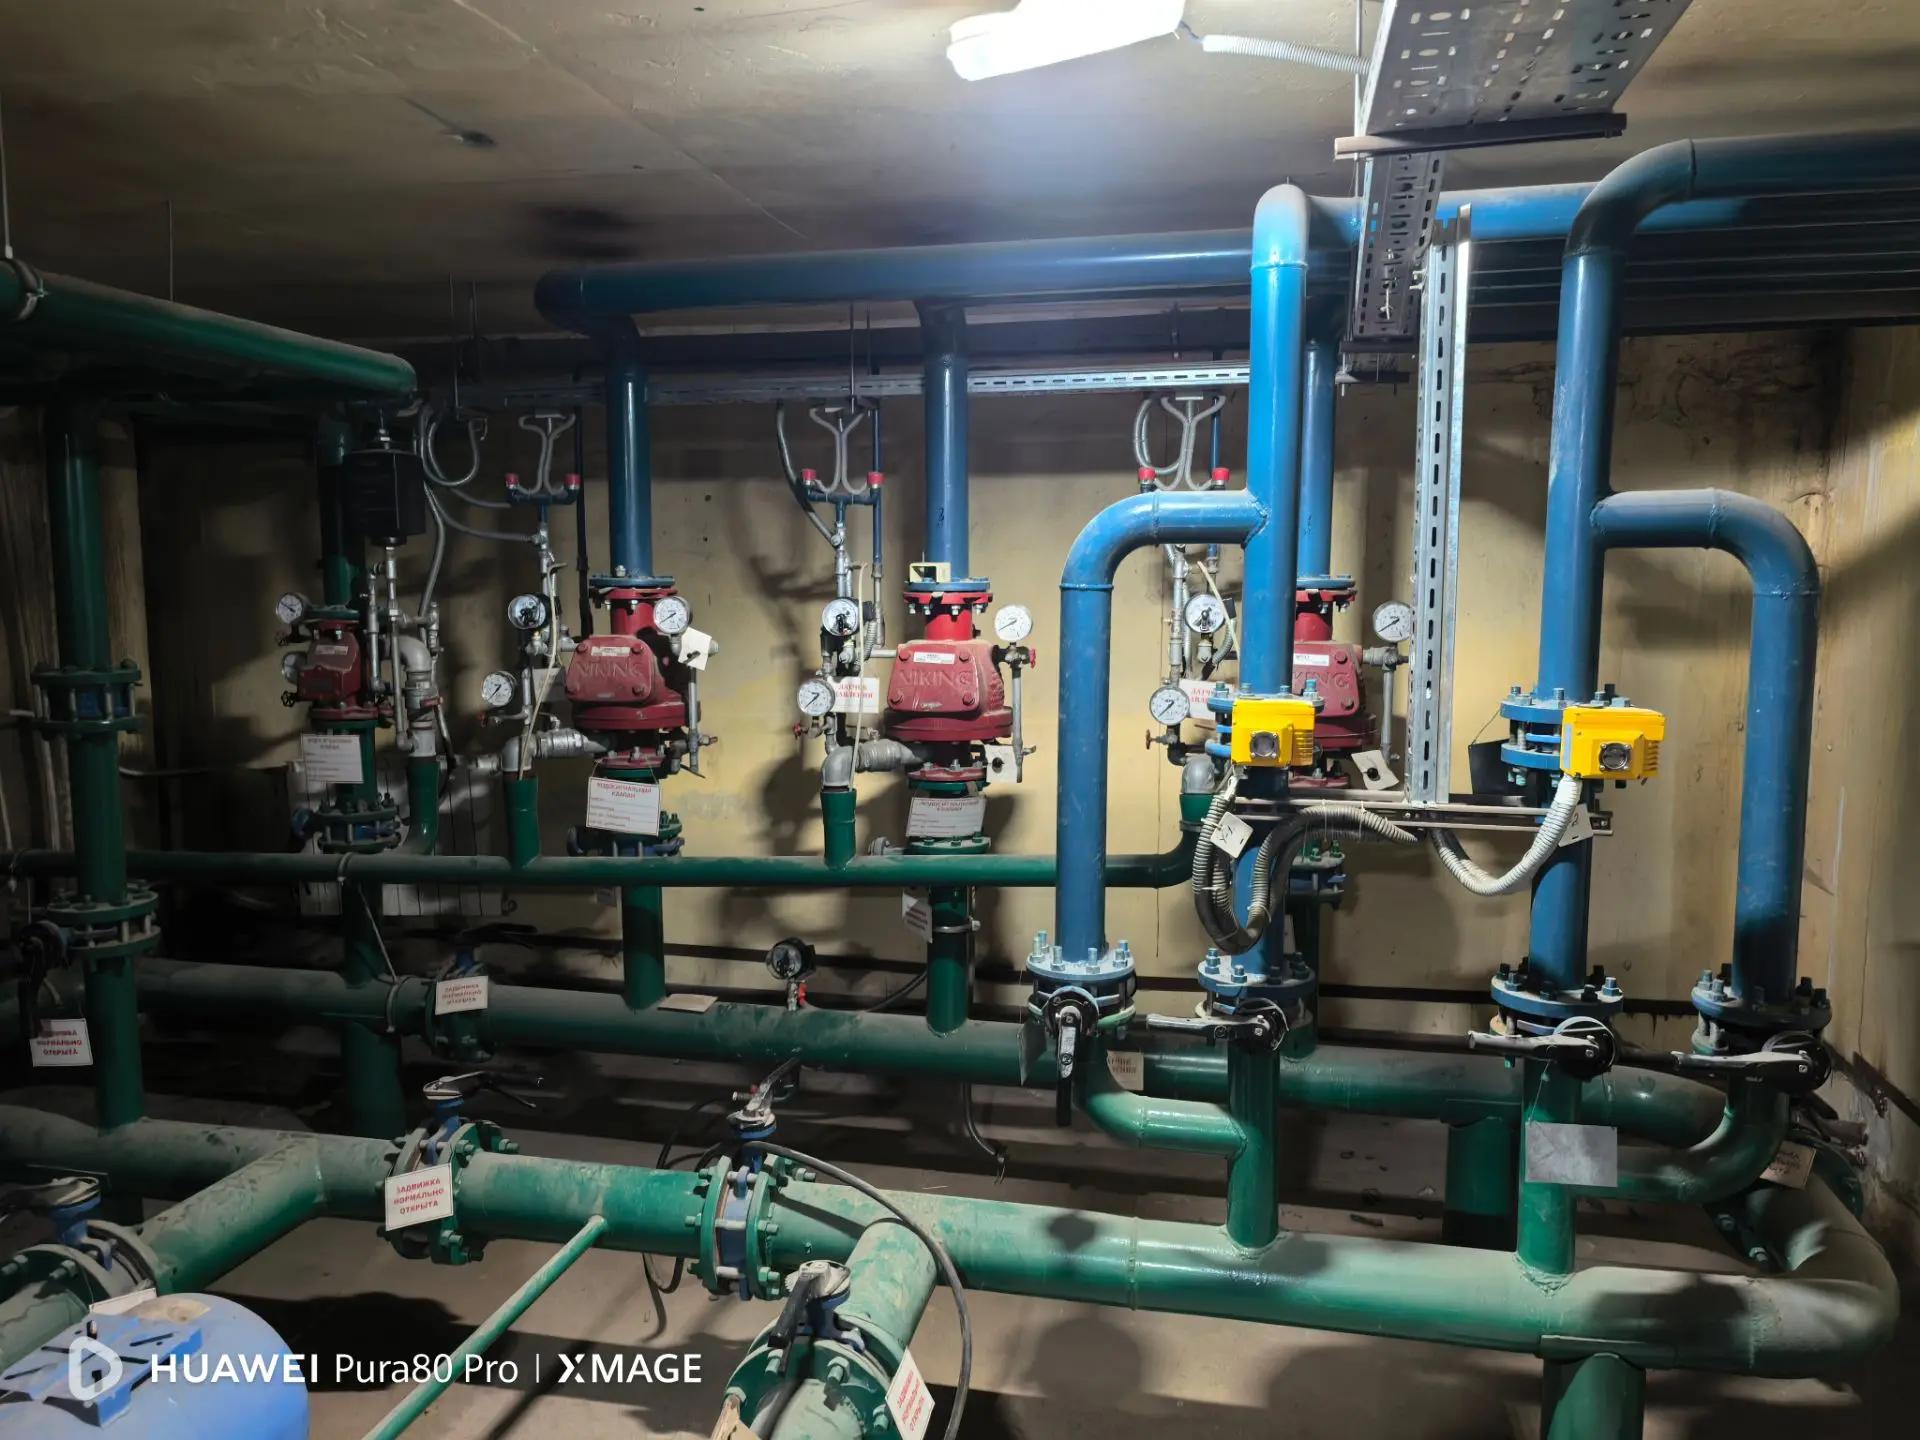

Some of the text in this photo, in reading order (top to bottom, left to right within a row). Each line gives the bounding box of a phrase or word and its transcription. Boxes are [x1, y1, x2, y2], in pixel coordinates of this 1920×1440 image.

[899, 669, 972, 687] VIKING
[1294, 671, 1350, 688] KING
[397, 1177, 441, 1194] ЗАДВИЖКА
[393, 1188, 444, 1205] НОРМАЛЬНО
[400, 1200, 438, 1215] ОТКРЫТА
